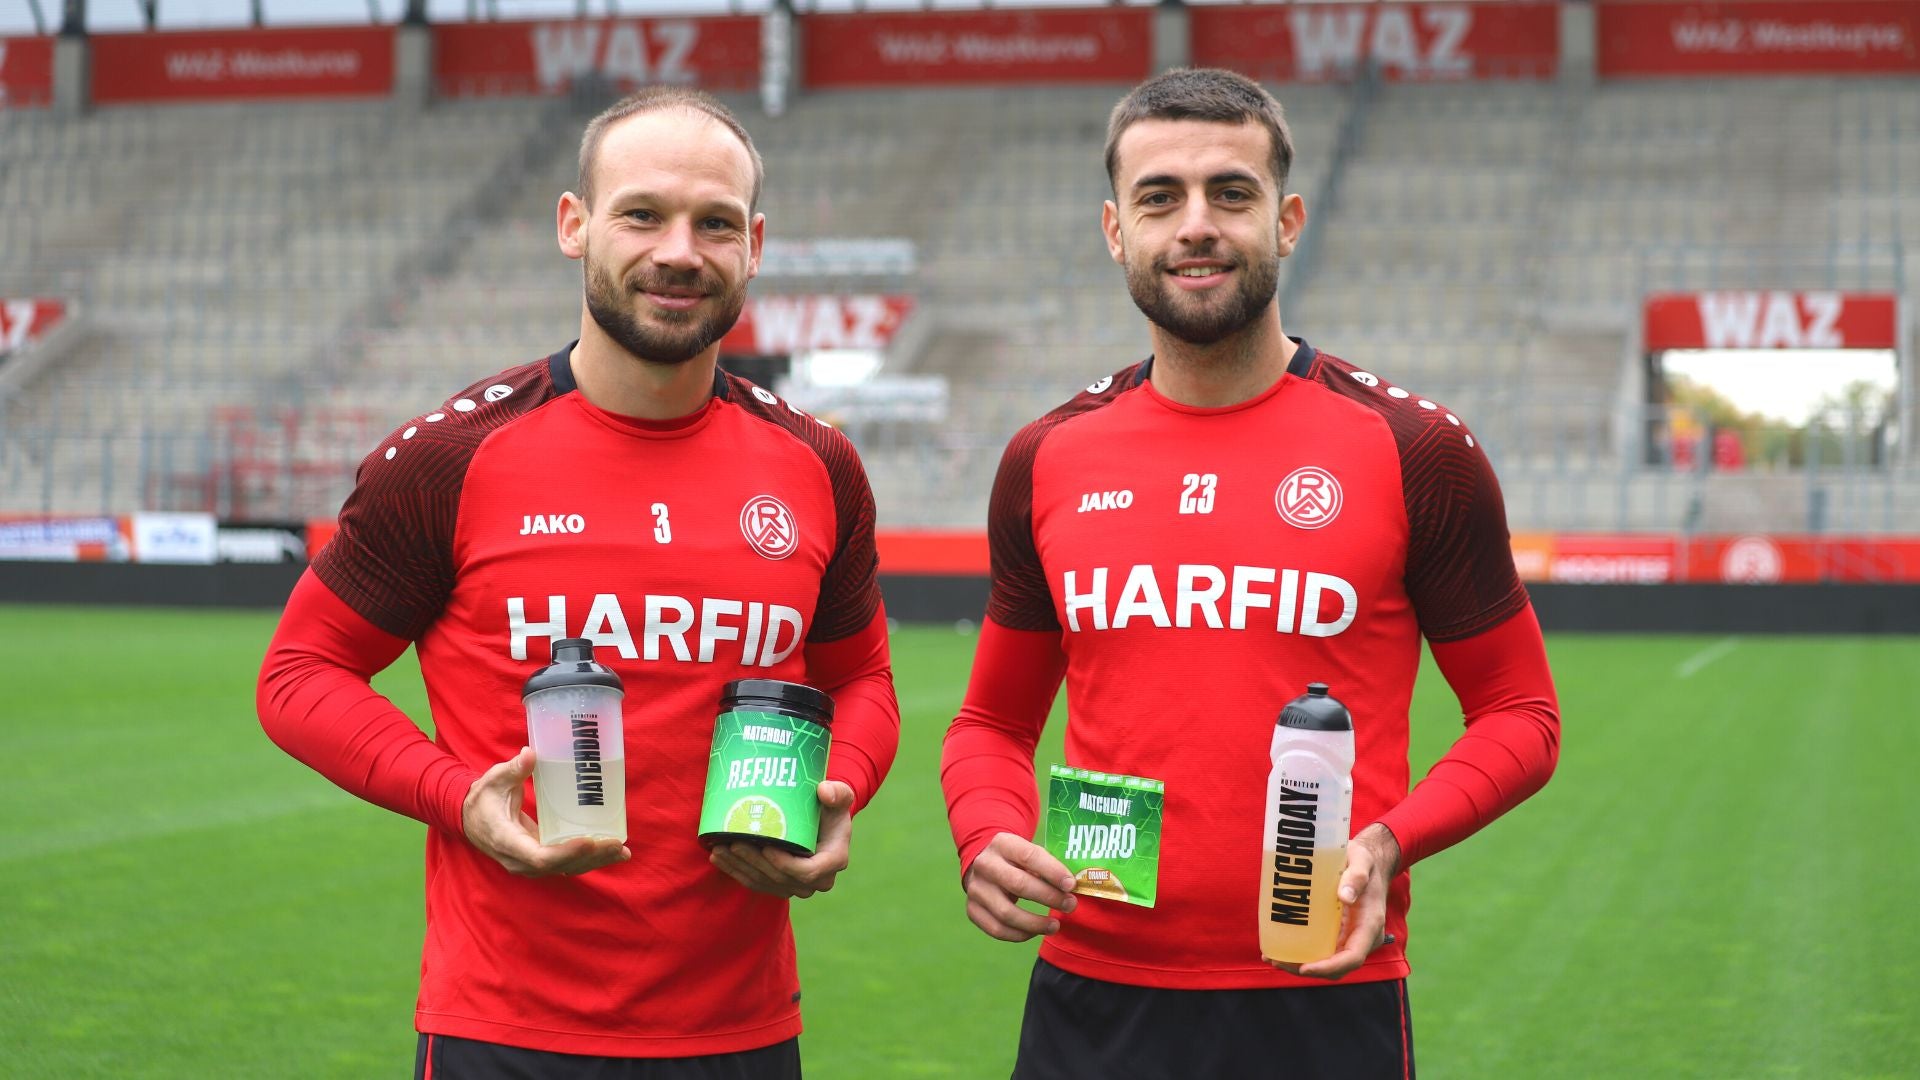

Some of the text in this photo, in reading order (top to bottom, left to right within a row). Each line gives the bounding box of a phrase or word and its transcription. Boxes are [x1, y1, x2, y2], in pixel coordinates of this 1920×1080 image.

[532, 20, 699, 88] WAZ
[1289, 7, 1474, 75] WAZ
[754, 295, 888, 353] WAZ
[1697, 291, 1845, 348] WAZ
[1077, 490, 1134, 513] JAKO
[1179, 473, 1218, 514] 23
[519, 513, 585, 535] JAKO
[651, 502, 672, 544] 3
[1064, 564, 1358, 637] HARFID
[506, 593, 803, 668] HARFID
[743, 725, 792, 746] MATCHDAY
[571, 718, 604, 806] MATCHDAY
[726, 756, 798, 790] REFUEL
[1079, 792, 1130, 817] MATCHDAY
[1065, 823, 1137, 860] HYDRO
[1270, 785, 1319, 926] MATCHDAY
[1088, 870, 1109, 880] ORANGE
